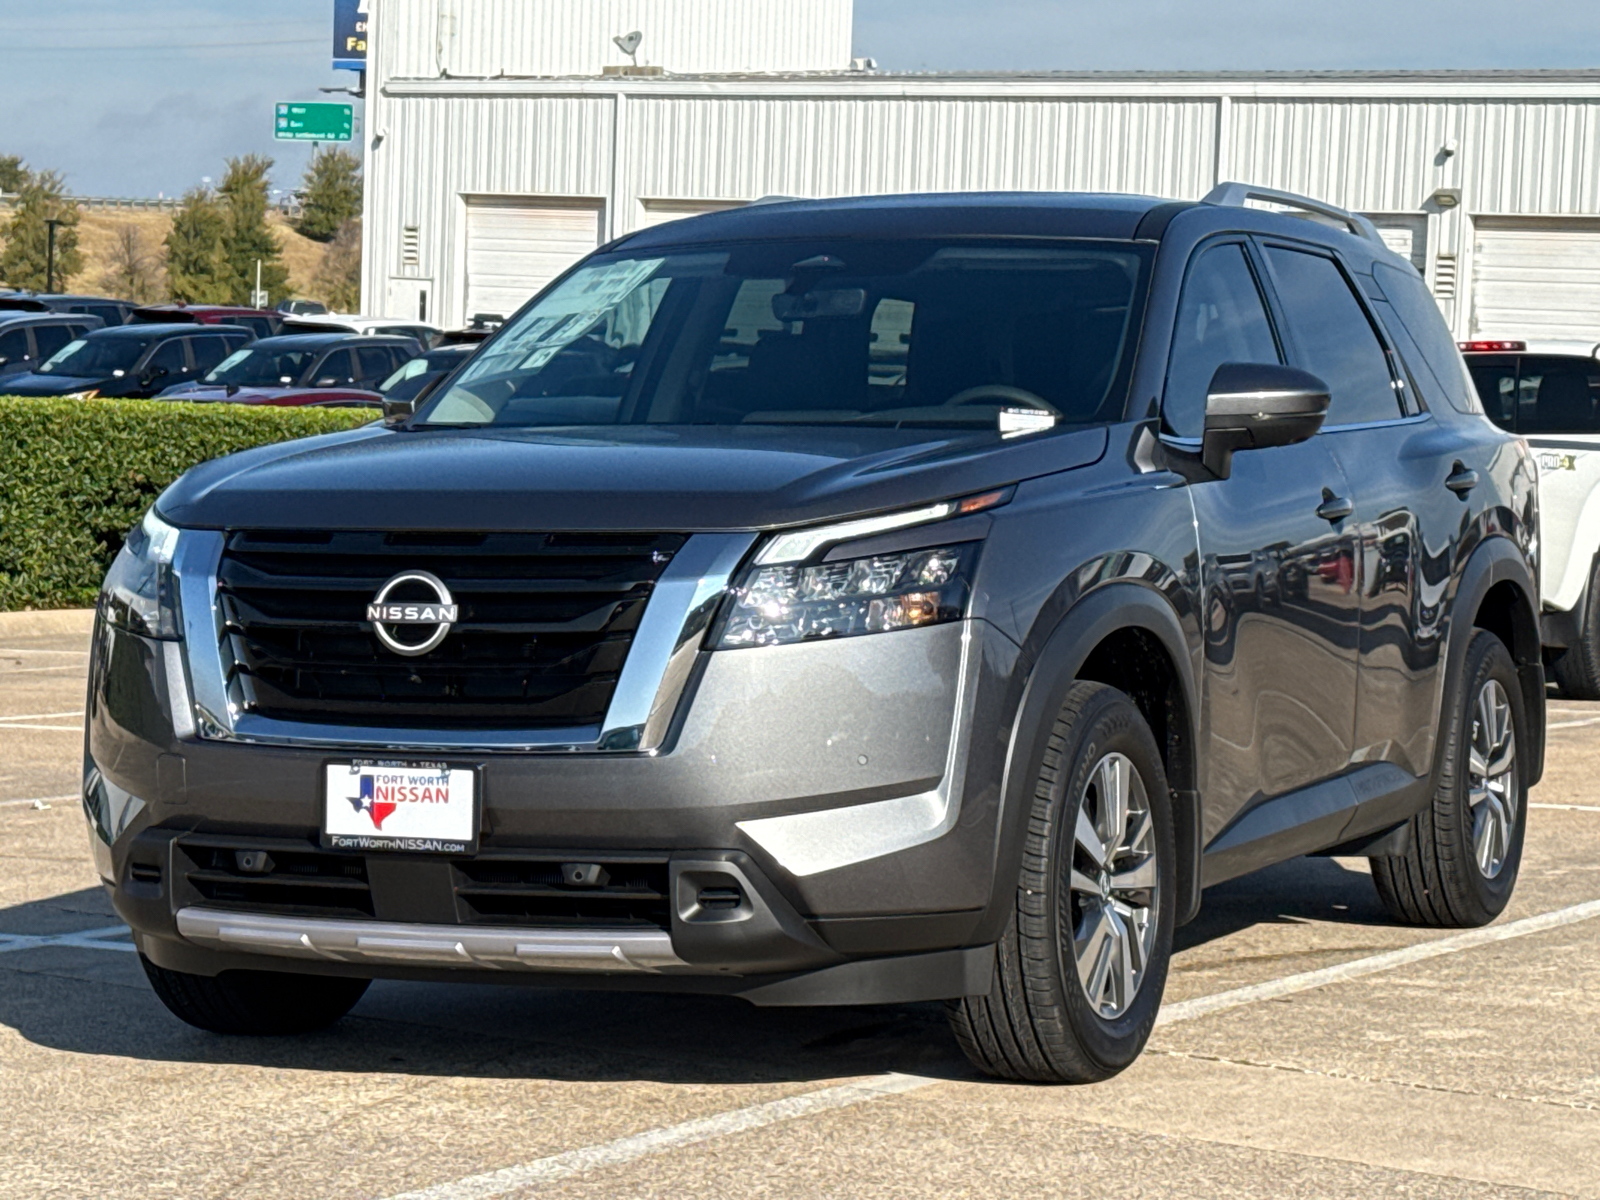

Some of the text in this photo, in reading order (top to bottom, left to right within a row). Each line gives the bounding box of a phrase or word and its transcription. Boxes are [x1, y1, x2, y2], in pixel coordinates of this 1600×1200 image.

[367, 605, 455, 620] NISSAN
[352, 758, 374, 766] FORT
[419, 761, 448, 769] TEXAS
[375, 775, 449, 786] FORT WORTH
[375, 786, 449, 804] NISSAN
